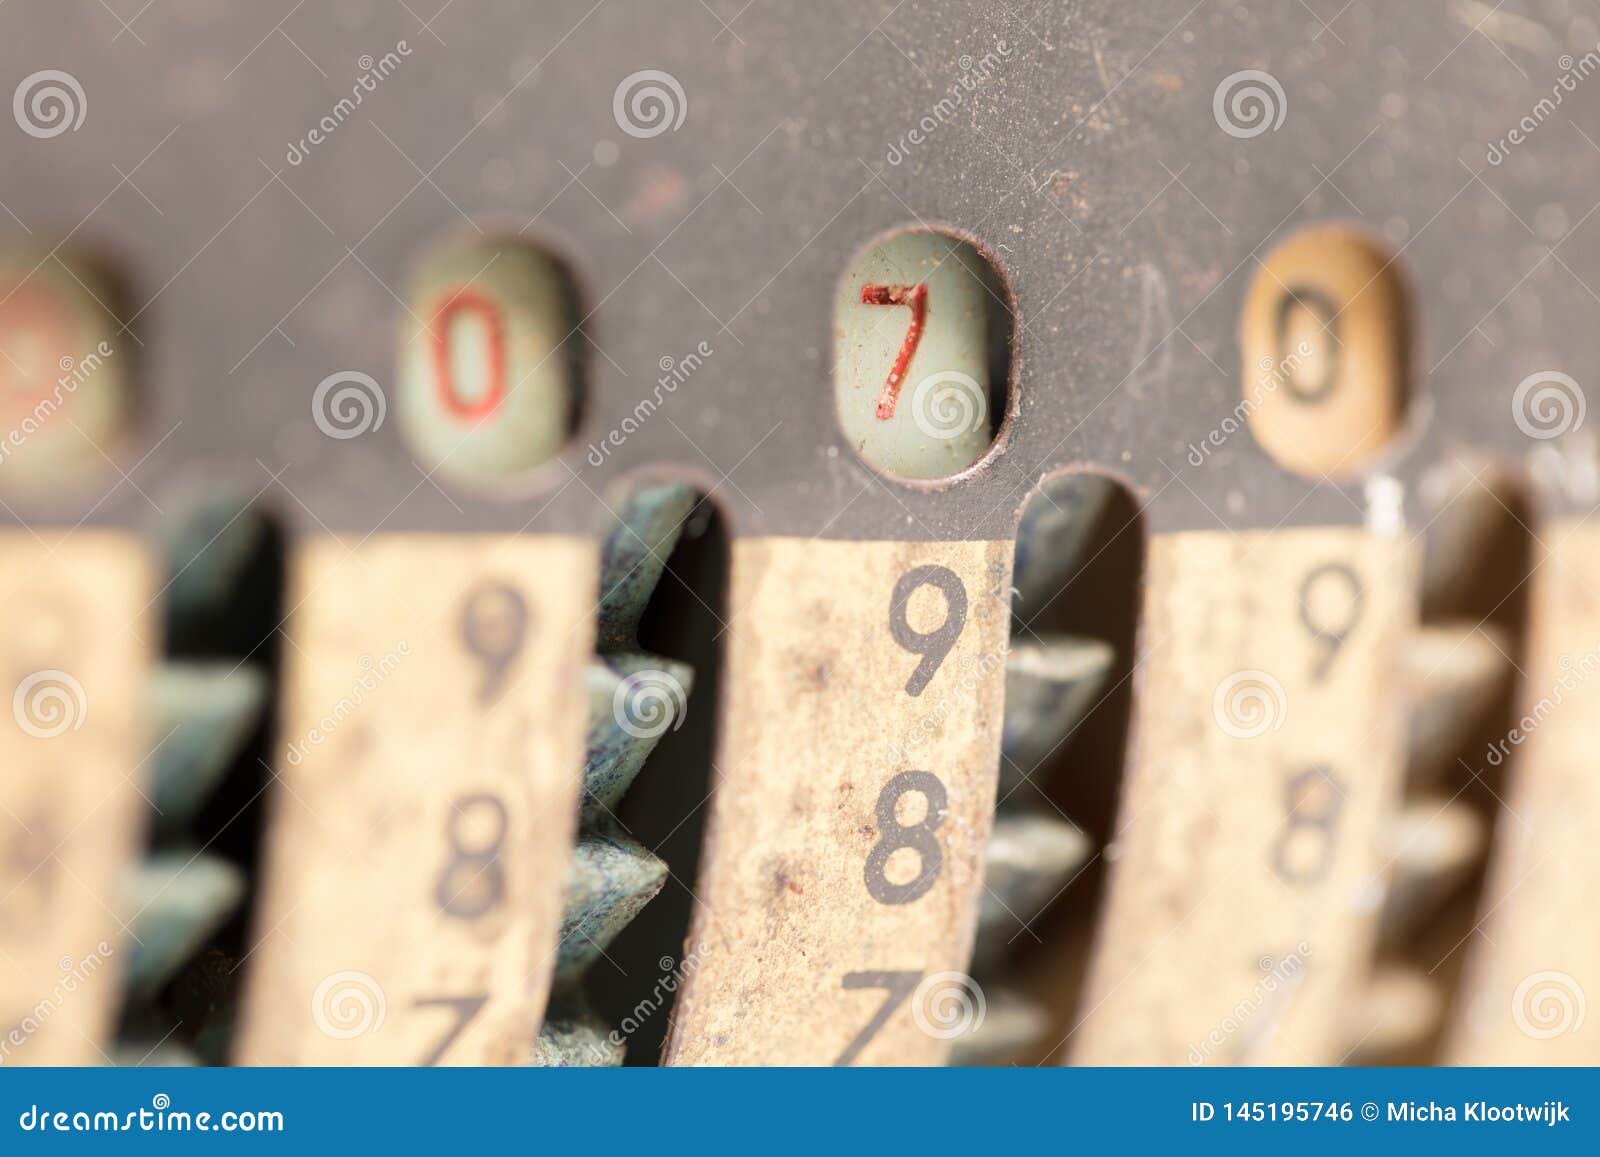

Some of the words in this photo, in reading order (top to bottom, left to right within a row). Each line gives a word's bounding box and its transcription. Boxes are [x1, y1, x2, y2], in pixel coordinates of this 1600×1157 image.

[430, 286, 506, 422] 0
[861, 283, 927, 421] 7
[1274, 284, 1342, 404] 0
[461, 580, 530, 704] 9
[888, 564, 967, 697] 9
[1297, 562, 1365, 682] 9
[436, 794, 509, 920] 8
[863, 770, 948, 905] 8
[1272, 763, 1350, 885] 8
[834, 970, 924, 1067] 7
